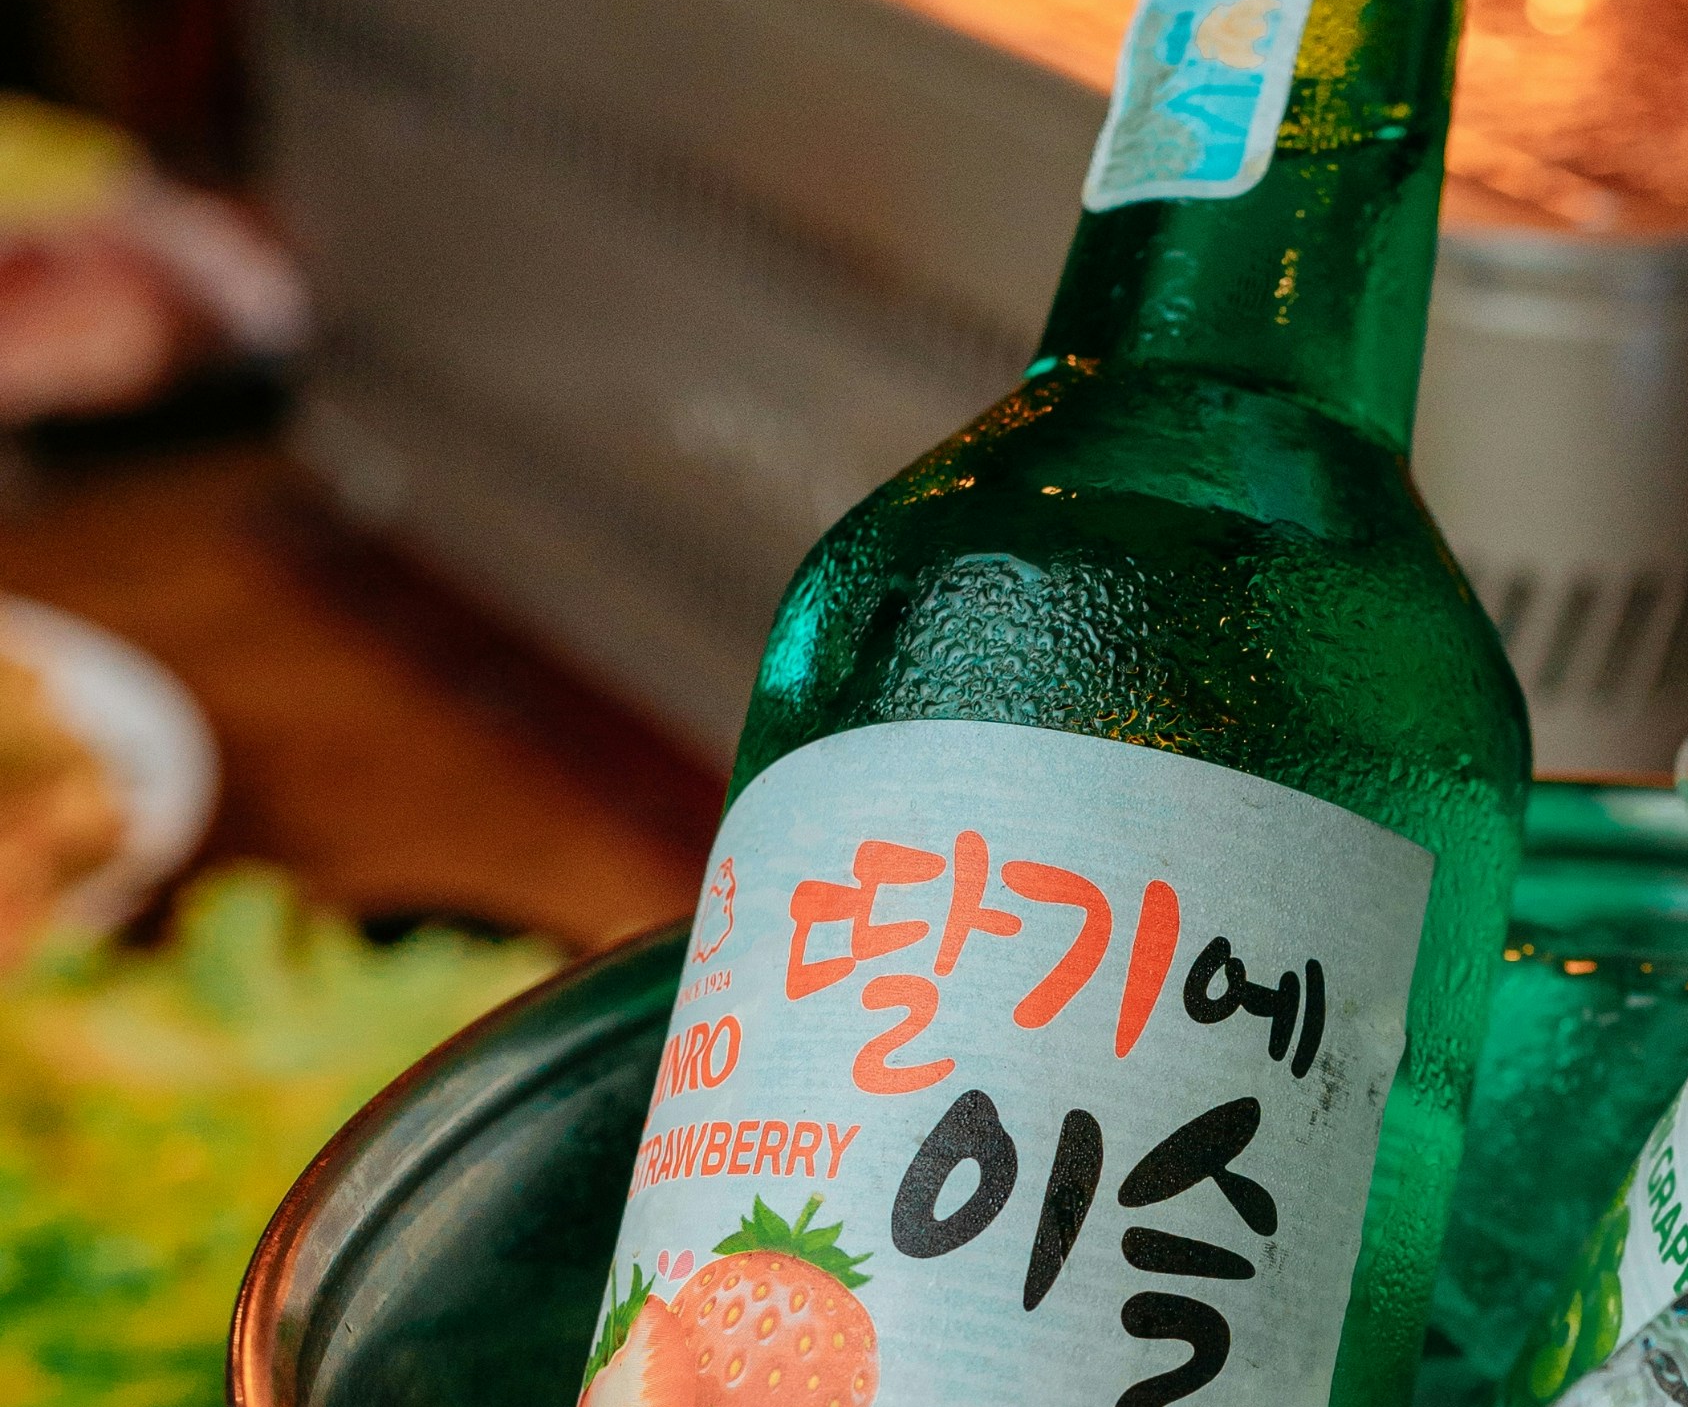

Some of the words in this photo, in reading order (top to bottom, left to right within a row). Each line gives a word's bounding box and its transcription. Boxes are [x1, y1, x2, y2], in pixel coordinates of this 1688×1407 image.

[704, 969, 732, 996] 1924
[785, 830, 1327, 1095] 딸기에
[643, 1014, 742, 1131] INRO
